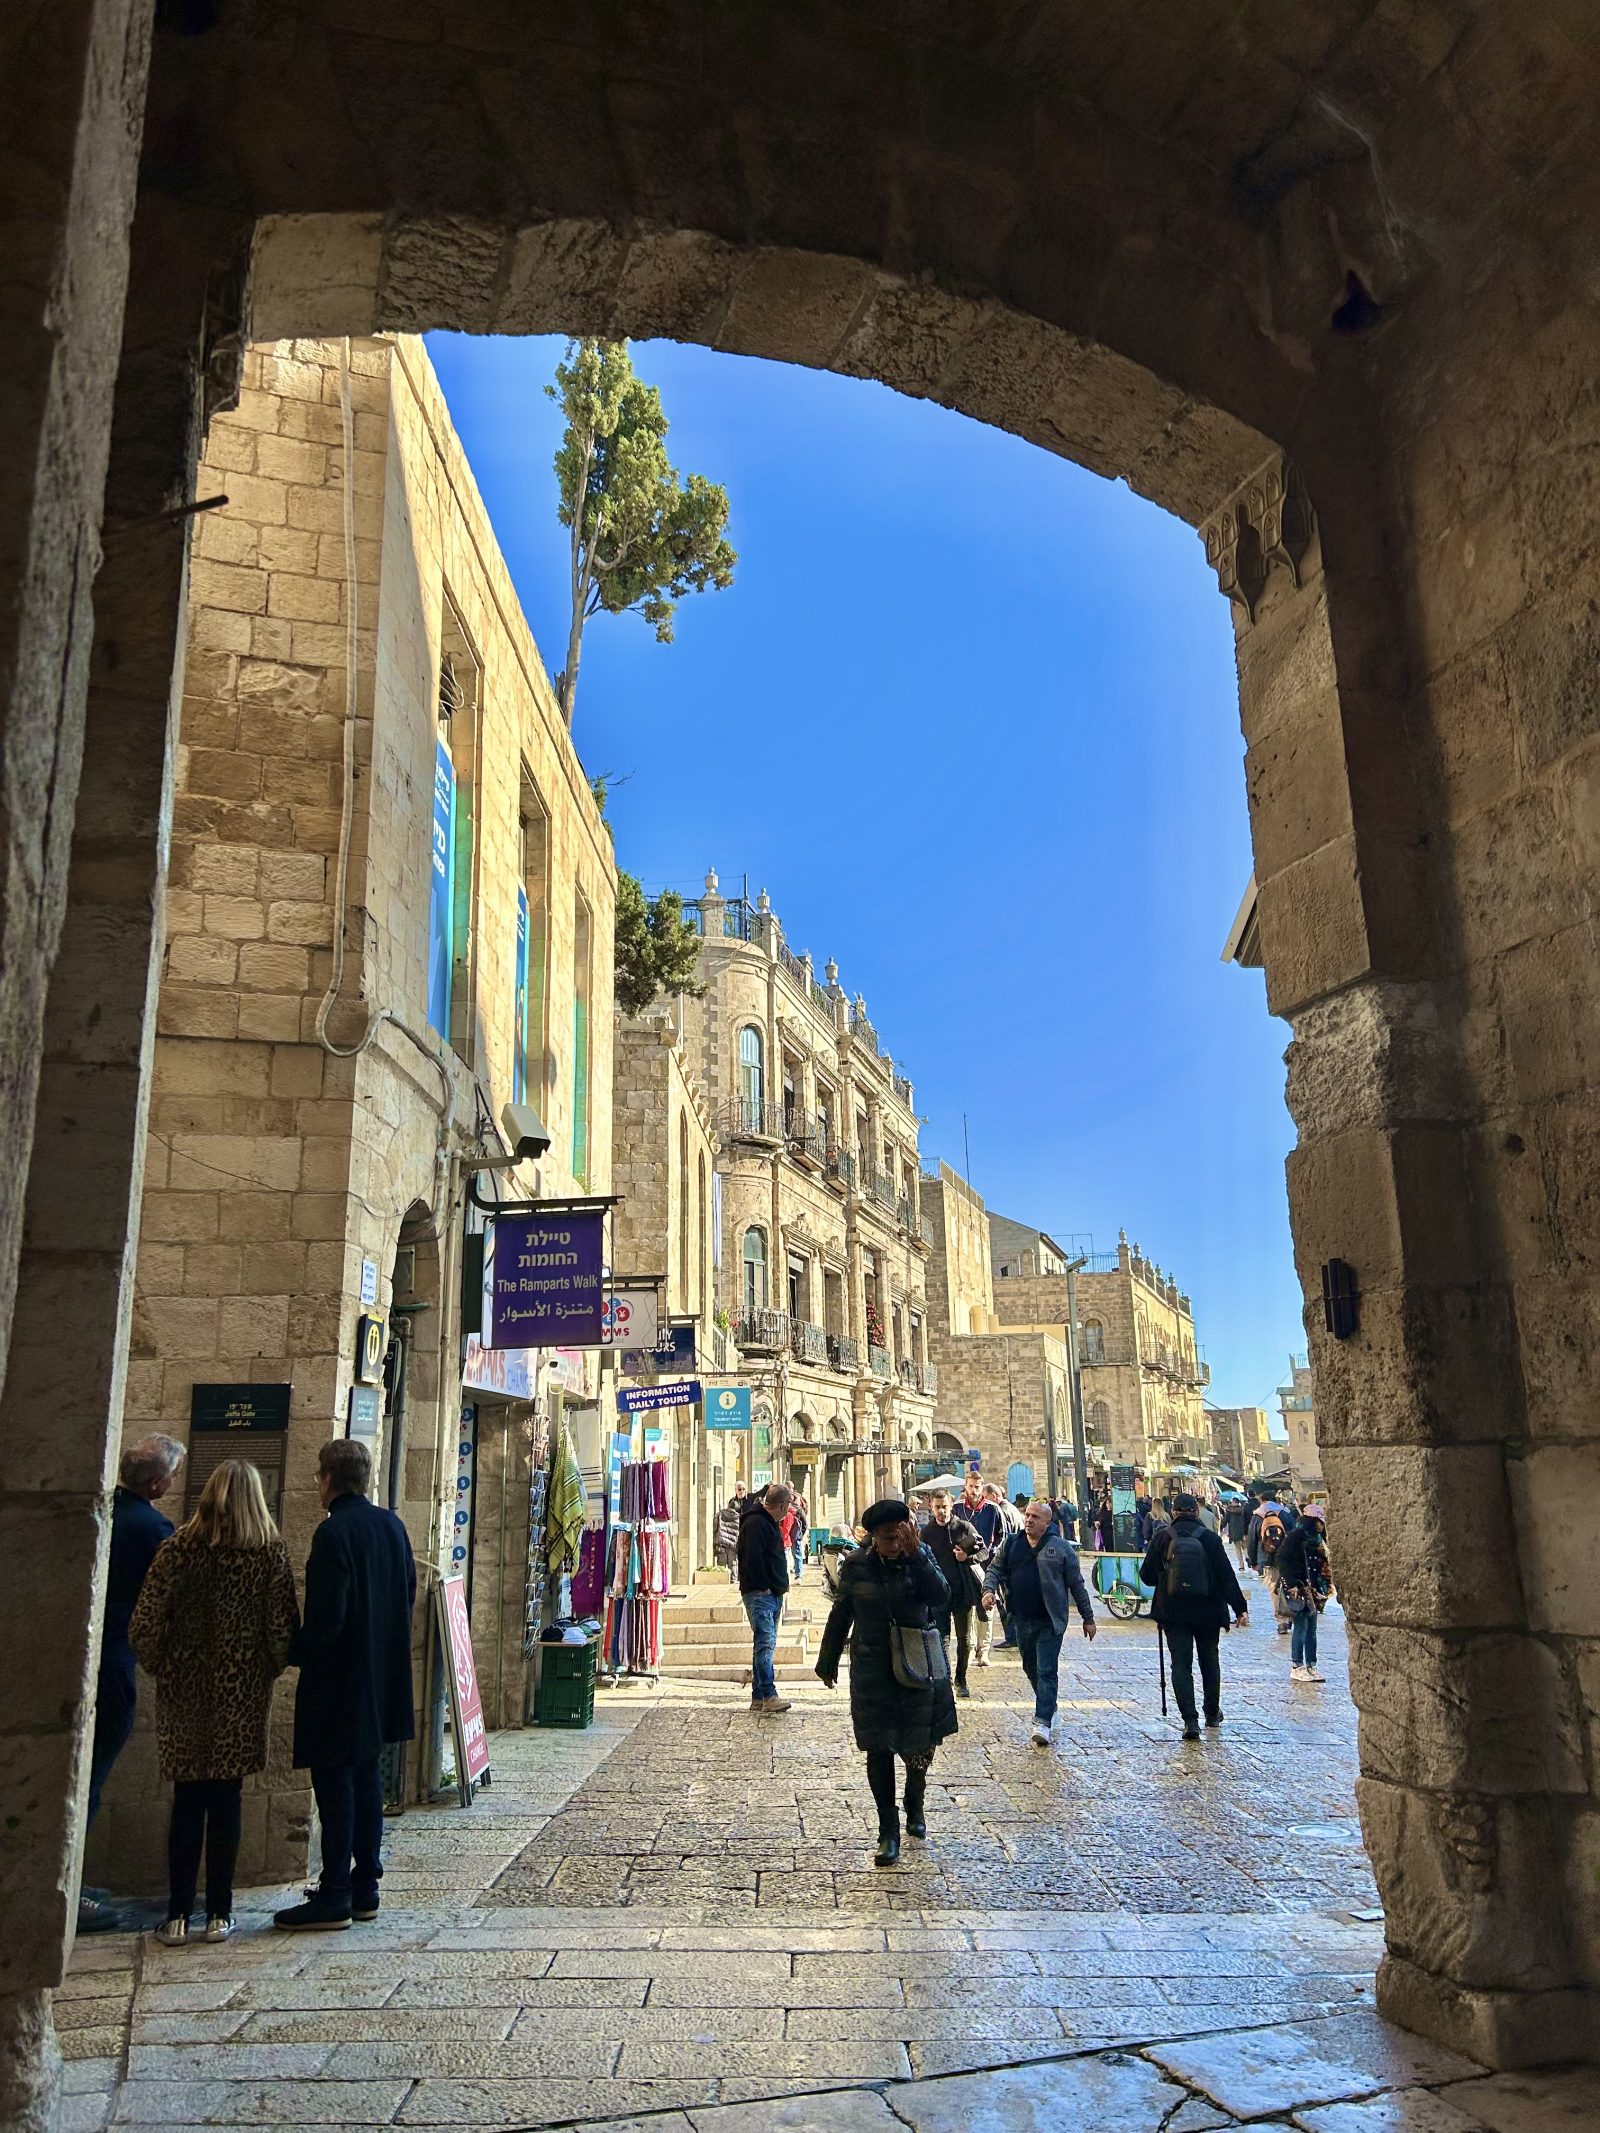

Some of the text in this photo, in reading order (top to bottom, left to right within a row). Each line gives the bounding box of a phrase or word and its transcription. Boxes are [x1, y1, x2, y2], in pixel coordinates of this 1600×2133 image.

[525, 1229, 571, 1247] טיילת
[517, 1252, 578, 1268] החומות
[497, 1274, 598, 1294] The Ramparts Walk
[625, 1384, 691, 1400] INFORMATION
[628, 1394, 690, 1410] DAILY TOURS
[754, 1473, 772, 1484] ATM
